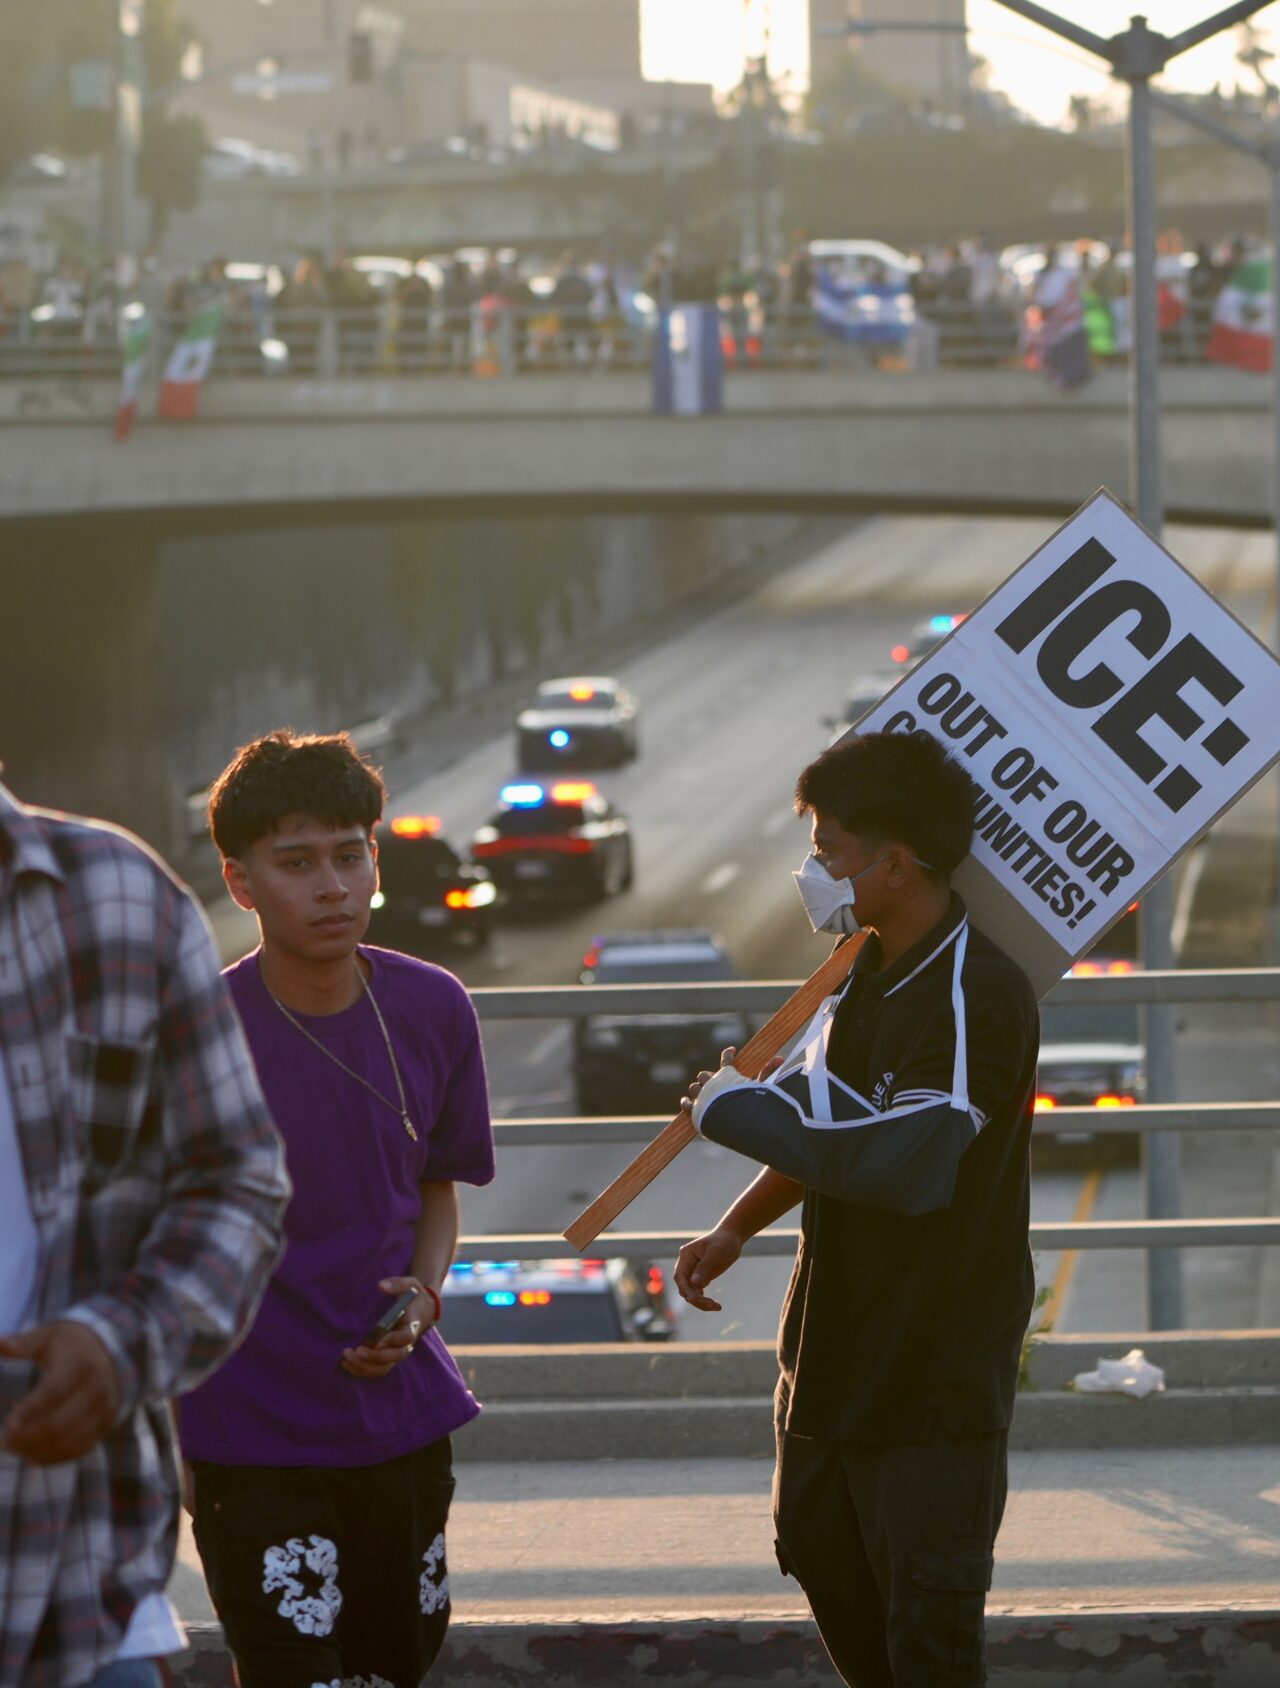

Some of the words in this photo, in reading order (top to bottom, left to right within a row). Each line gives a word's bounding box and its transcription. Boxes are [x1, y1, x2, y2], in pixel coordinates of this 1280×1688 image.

[917, 672, 1009, 758] OUT
[991, 747, 1059, 805] OF
[1043, 800, 1135, 896] OUR
[994, 536, 1250, 813] ICE:
